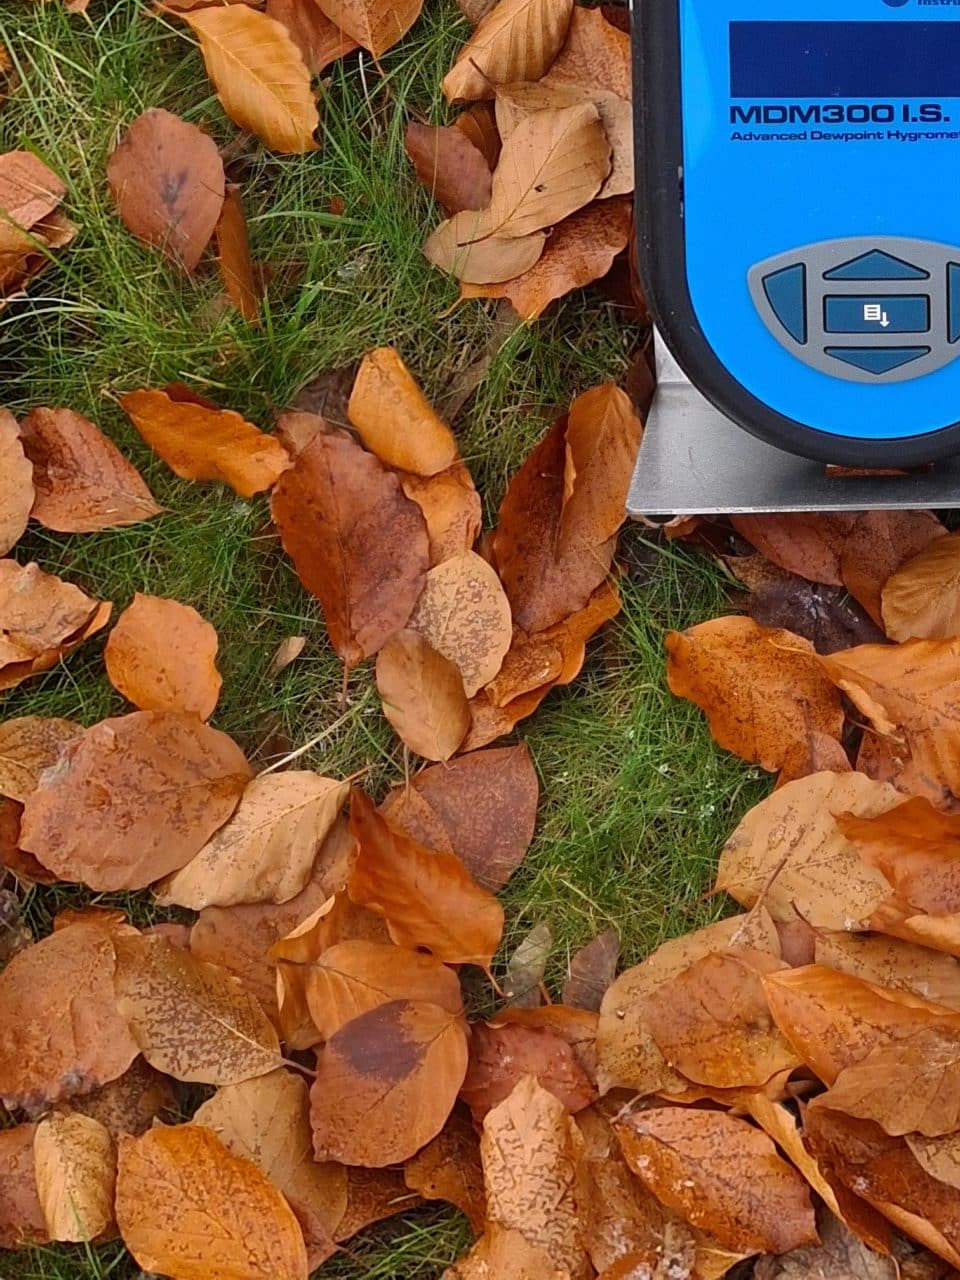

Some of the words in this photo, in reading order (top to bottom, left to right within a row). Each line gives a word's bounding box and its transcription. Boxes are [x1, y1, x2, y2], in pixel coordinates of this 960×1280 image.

[730, 104, 895, 124] MDM300
[902, 103, 951, 123] I.S.
[730, 131, 807, 142] Advanced
[810, 130, 884, 143] Dewpoint
